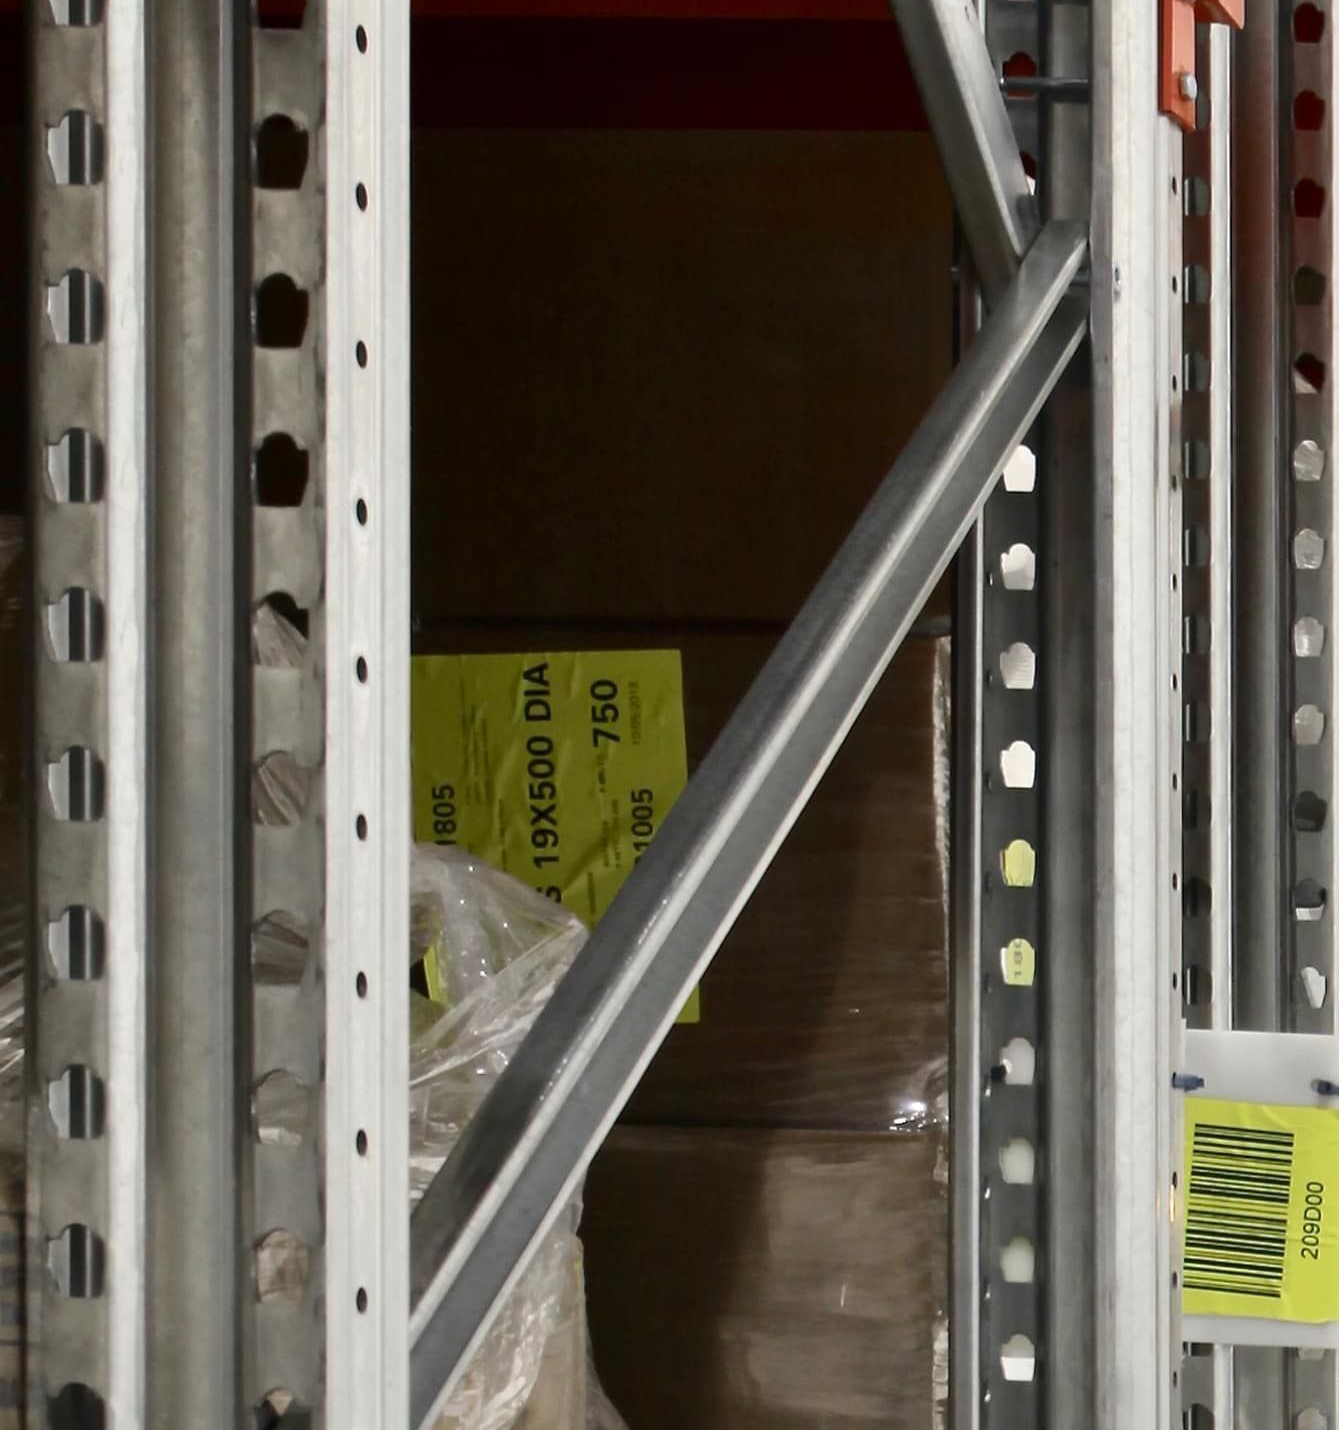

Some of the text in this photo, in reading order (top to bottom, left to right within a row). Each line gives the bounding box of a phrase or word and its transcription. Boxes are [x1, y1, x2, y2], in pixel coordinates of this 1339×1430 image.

[522, 663, 552, 722] DIA
[590, 678, 621, 748] 750
[526, 736, 560, 869] 19X500
[1301, 1181, 1324, 1260] 209D00
